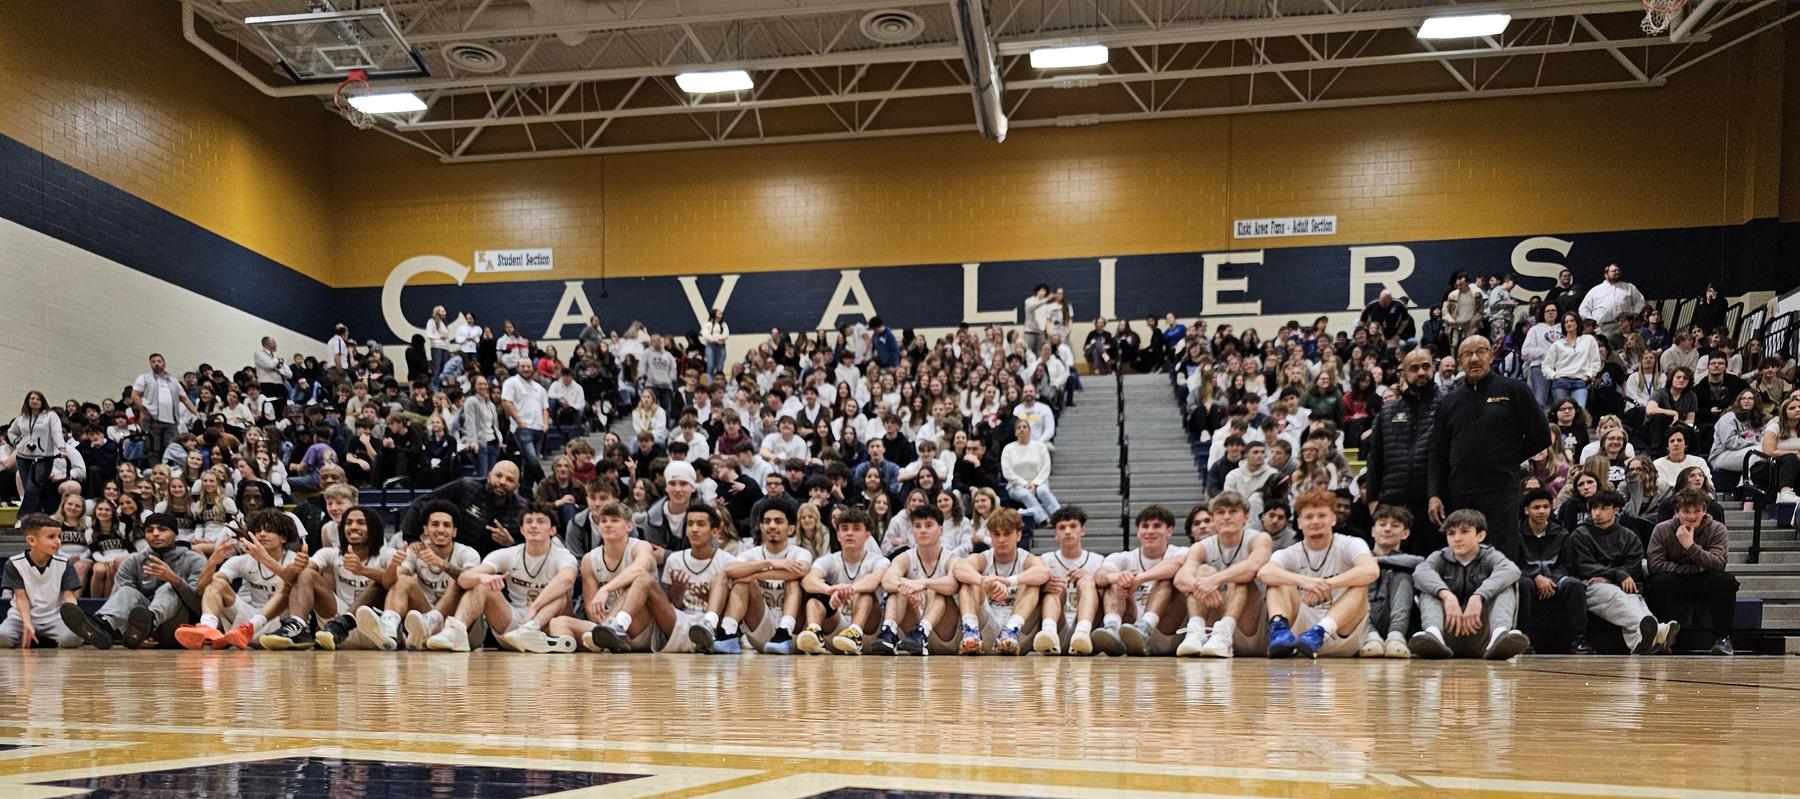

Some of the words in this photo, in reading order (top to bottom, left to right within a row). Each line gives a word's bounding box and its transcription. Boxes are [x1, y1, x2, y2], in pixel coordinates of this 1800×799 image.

[1254, 222, 1269, 235] Area
[1292, 219, 1309, 233] Adult
[1311, 219, 1333, 232] Section
[497, 253, 524, 267] Student
[525, 252, 551, 266] Section
[381, 236, 1574, 345] CAVALIERS
